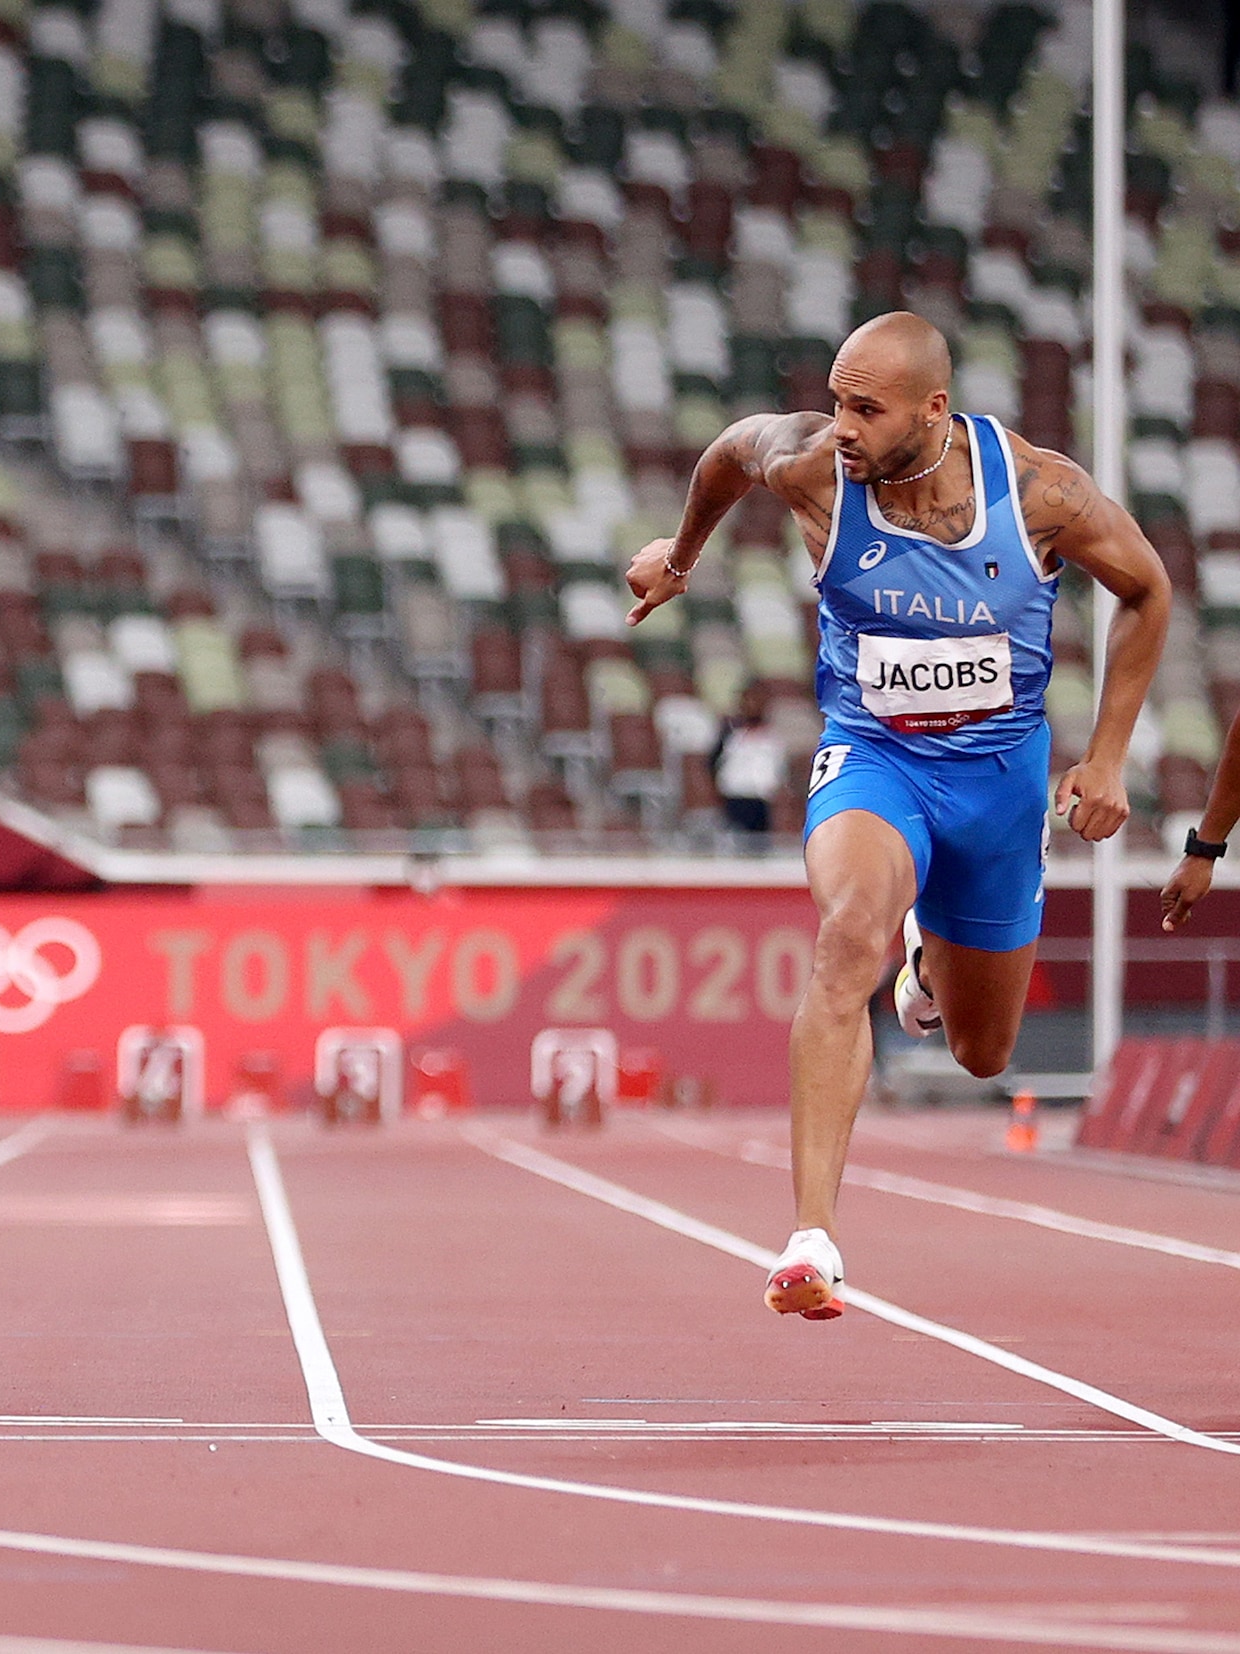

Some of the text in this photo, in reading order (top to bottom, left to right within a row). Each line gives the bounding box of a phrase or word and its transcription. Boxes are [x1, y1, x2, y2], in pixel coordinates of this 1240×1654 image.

[872, 588, 997, 626] ITALIA
[871, 657, 998, 692] JACOBS
[145, 924, 813, 1024] TOKYO 2020
